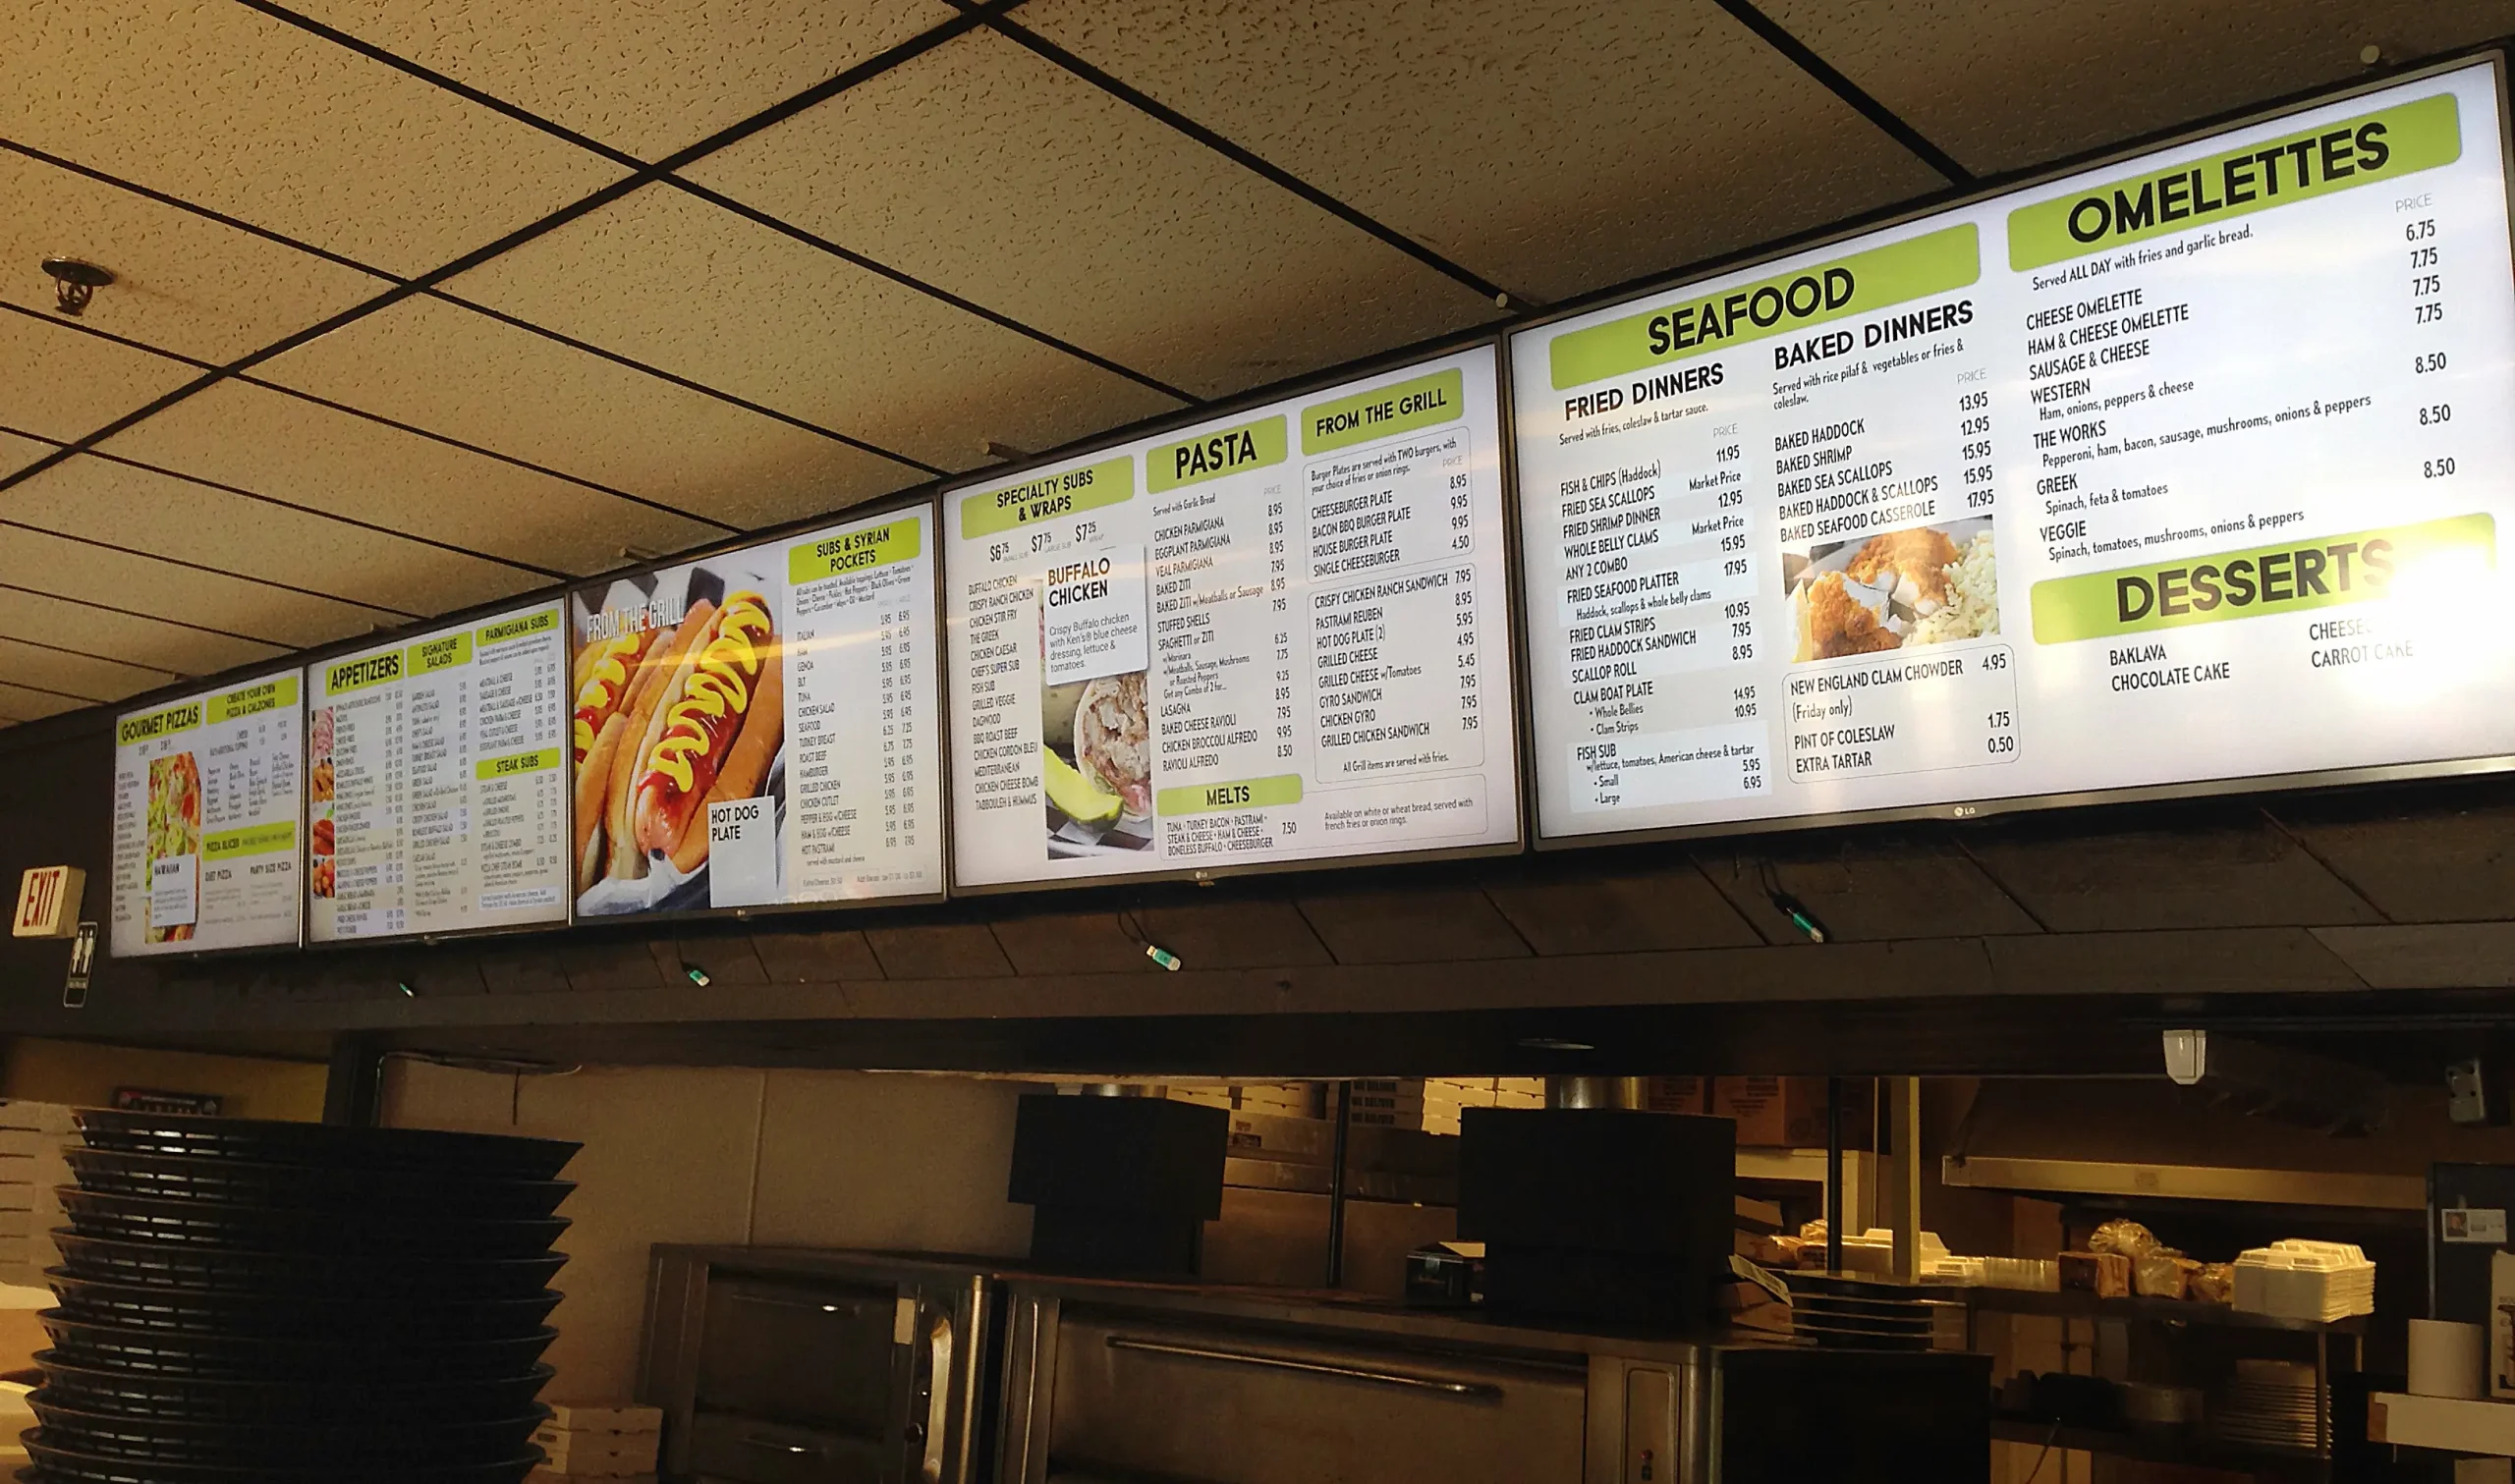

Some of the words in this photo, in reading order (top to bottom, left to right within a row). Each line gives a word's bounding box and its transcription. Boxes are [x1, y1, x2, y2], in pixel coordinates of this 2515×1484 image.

[2067, 121, 2389, 244] OMELETTES
[2405, 218, 2435, 242] 6.75
[2032, 268, 2067, 292] Served
[2068, 263, 2089, 282] ALL
[2090, 257, 2111, 277] DAY
[2113, 251, 2136, 269] with
[2138, 248, 2162, 265] fries
[2164, 239, 2184, 258] and
[2186, 233, 2216, 256] garlic
[2217, 222, 2253, 245] bread.
[2410, 246, 2438, 269] 7.75
[1648, 266, 1855, 356] SEAFOOD
[2026, 303, 2074, 331] CHEESE
[2076, 287, 2143, 319] OMELETTE
[1773, 330, 1854, 370] BAKED
[1864, 299, 1974, 349] DINNERS
[2027, 334, 2055, 356] HAM
[2058, 332, 2067, 349] &
[2069, 319, 2118, 346] CHEESE
[2121, 302, 2190, 335] OMELETTE
[2415, 352, 2446, 374] 8.50
[1564, 387, 1624, 421] FRIED
[1631, 361, 1724, 406] DINNERS
[1958, 390, 1988, 412] 13.95
[2030, 377, 2091, 405] WESTERN
[2039, 406, 2064, 421] Ham,
[2066, 399, 2101, 415] onions,
[2103, 390, 2147, 412] peppers
[2148, 383, 2156, 399] &
[2157, 380, 2194, 397] cheese
[1315, 409, 1360, 438] FROM
[1364, 400, 1394, 424] THE
[1398, 387, 1448, 415] GRILL
[1558, 428, 1585, 446] Served
[1585, 424, 1600, 438] with
[1600, 422, 1621, 436] fries,
[1622, 413, 1652, 431] coleslaw
[1652, 410, 1659, 423] &
[1660, 409, 1684, 422] tartar
[1684, 404, 1708, 416] sauce.
[1774, 430, 1810, 452] BAKED
[1811, 417, 1866, 444] HADDOCK
[2032, 429, 2057, 450] THE
[2058, 419, 2106, 443] WORKS
[1175, 428, 1258, 480] PASTA
[1715, 443, 1740, 463] 11.95
[996, 476, 1060, 509] SPECIALTY
[1062, 467, 1093, 492] SUBS
[1449, 472, 1467, 490] 8.95
[1560, 478, 1581, 497] FISH
[1581, 477, 1589, 492] &
[1589, 470, 1617, 490] CHIPS
[1618, 458, 1661, 486] (Haddock)
[1688, 473, 1719, 491] Market
[1719, 469, 1742, 485] Price
[2036, 472, 2078, 496] GREEK
[1018, 506, 1028, 522] &
[1029, 494, 1072, 519] WRAPS
[1267, 501, 1283, 518] 8.95
[1311, 495, 1369, 520] CHEESEBURGER
[1369, 489, 1393, 508] PLATE
[1450, 493, 1468, 510] 9.95
[1561, 499, 1588, 519] FRIED
[1588, 496, 1607, 513] SEA
[1607, 484, 1655, 509] SCALLOPS
[1153, 524, 1183, 543] CHICKEN
[1183, 516, 1225, 536] PARMIGIANA
[1312, 521, 1338, 539] BACON
[1338, 518, 1356, 534] BBQ
[1356, 511, 1387, 530] BURGER
[1387, 505, 1412, 523] PLATE
[815, 538, 841, 559] SUBS
[843, 536, 852, 552] &
[854, 526, 890, 550] SYRIAN
[829, 548, 876, 573] POCKETS
[1047, 556, 1111, 587] BUFFALO
[1048, 578, 1108, 608] CHICKEN
[1155, 580, 1178, 596] BAKED
[1178, 577, 1192, 592] ZITI
[2117, 538, 2396, 623] DESSERTS
[484, 619, 529, 641] PARMIGIANA
[530, 614, 549, 631] SUBS
[587, 607, 618, 643] FROM
[623, 601, 645, 635] THE
[649, 592, 684, 630] GRILL
[1048, 624, 1072, 636] Crispy
[1072, 617, 1100, 632] Buffalo
[1099, 612, 1130, 627] chicken
[1156, 616, 1186, 633] STUFFED
[1186, 611, 1210, 629] SHELLS
[420, 637, 458, 658] SIGNATURE
[1049, 635, 1065, 648] with
[1092, 629, 1110, 641] blue
[1110, 624, 1138, 637] cheese
[1083, 641, 1109, 655] lettuce
[1109, 638, 1116, 650] &
[425, 651, 453, 669] SALADS
[1982, 652, 2006, 671] 4.95
[2109, 643, 2167, 666] BAKLAVA
[330, 653, 400, 691] APPETIZERS
[1790, 678, 1816, 696] NEW
[1817, 671, 1869, 692] ENGLAND
[1871, 668, 1903, 686] CLAM
[1904, 658, 1964, 682] CHOWDER
[2111, 666, 2191, 692] CHOCOLATE
[2193, 661, 2230, 683] CAKE
[121, 713, 165, 742] GOURMET
[165, 704, 198, 731] PIZZAS
[972, 712, 1001, 728] DAGWOOD
[1159, 701, 1192, 718] LASAGNA
[495, 757, 519, 774] STEAK
[520, 753, 539, 769] SUBS
[1343, 760, 1352, 772] All
[1352, 758, 1367, 772] Grill
[1367, 759, 1384, 770] items
[1384, 759, 1395, 768] are
[1395, 753, 1418, 767] served
[1418, 751, 1431, 764] with
[1621, 755, 1657, 768] tomatoes,
[1657, 750, 1695, 764] American
[1695, 746, 1722, 760] cheese
[1722, 743, 1730, 757] &
[1730, 743, 1755, 756] tartar
[1205, 785, 1251, 806] MELTS
[710, 806, 732, 825] HOT
[734, 803, 759, 822] DOG
[711, 824, 741, 843] PLATE
[23, 869, 60, 927] EXIT
